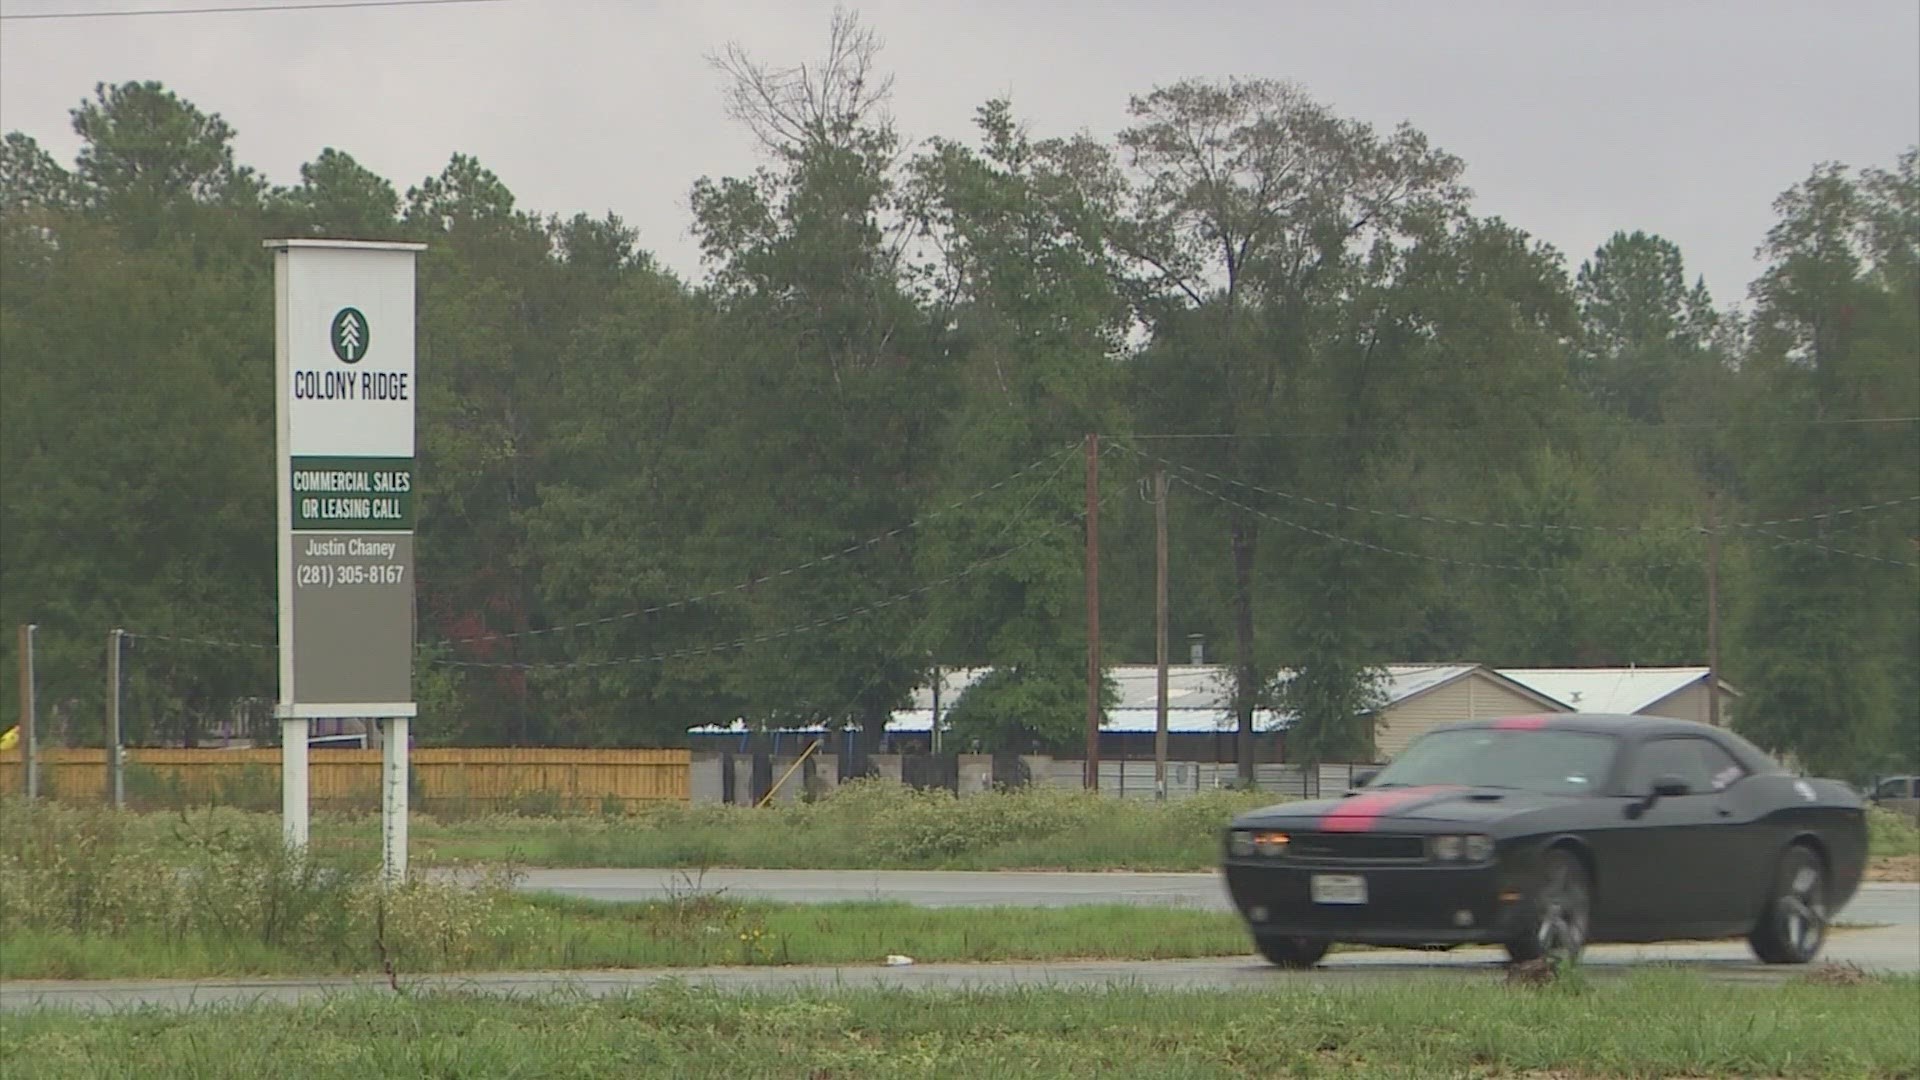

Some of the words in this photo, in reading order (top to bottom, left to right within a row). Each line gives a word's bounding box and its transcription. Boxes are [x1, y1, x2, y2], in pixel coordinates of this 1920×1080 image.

[295, 371, 356, 400] COLONY
[362, 371, 408, 400] RIDGE
[293, 471, 371, 492] COMMERCIAL
[373, 471, 410, 492] SALES
[302, 499, 319, 519] OR
[321, 498, 371, 519] LEASING
[372, 498, 401, 518] CALL
[305, 538, 346, 556] Justin
[348, 538, 396, 560] Chaney
[296, 564, 334, 588] (281)
[336, 565, 404, 584] 305-8167
